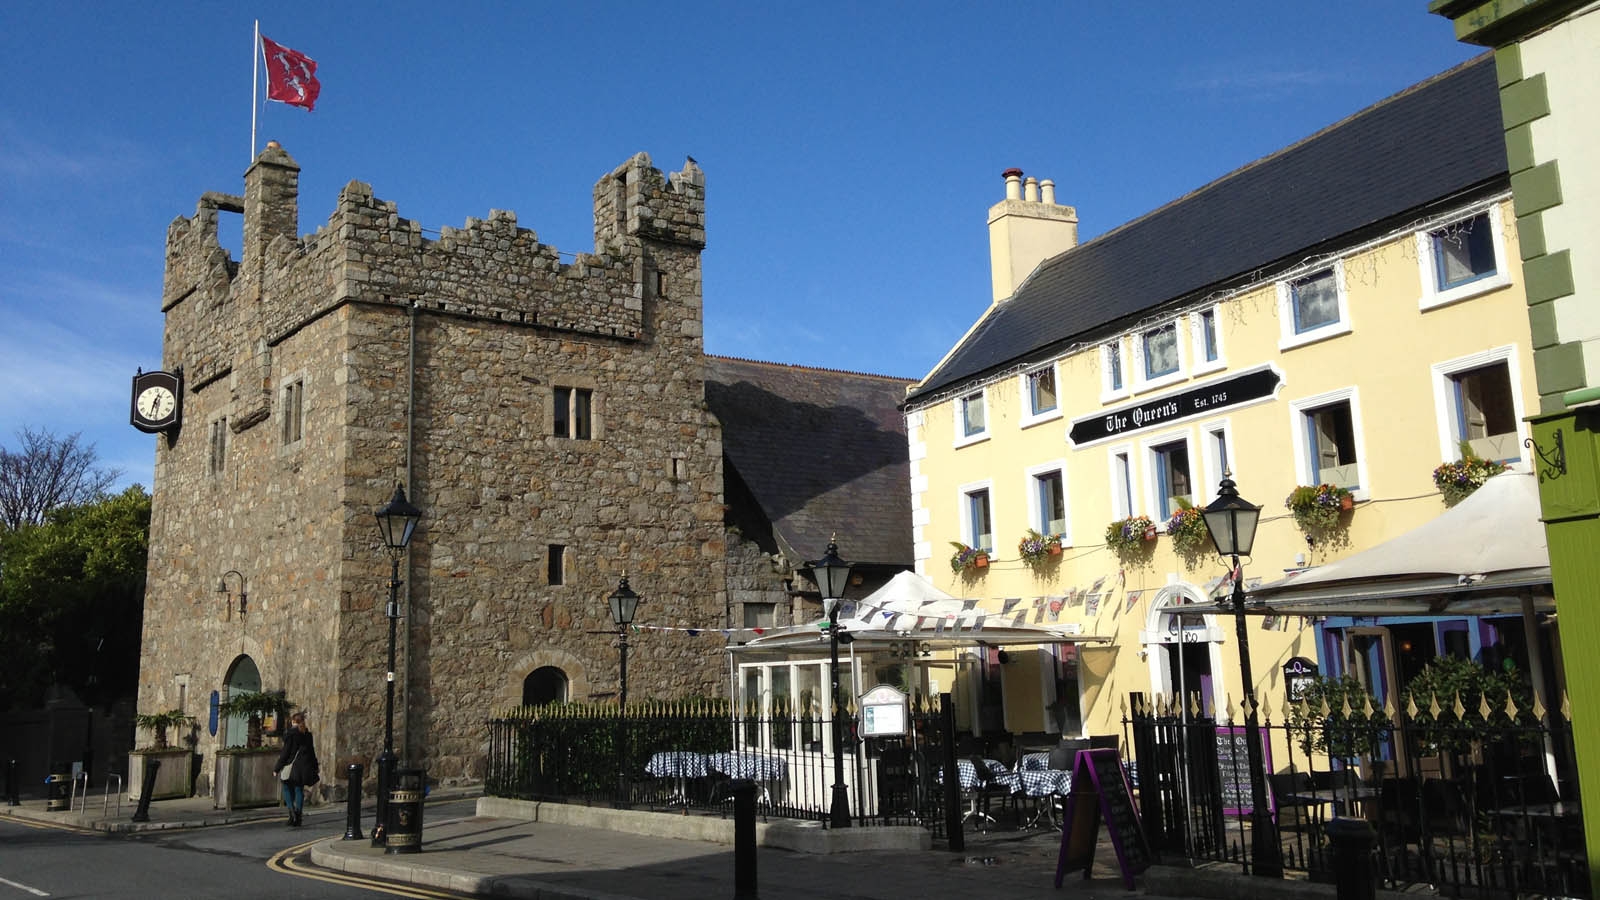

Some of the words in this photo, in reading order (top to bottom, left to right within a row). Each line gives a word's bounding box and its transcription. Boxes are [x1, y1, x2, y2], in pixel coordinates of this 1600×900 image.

[1106, 415, 1128, 433] The
[1133, 402, 1178, 427] Queen's
[1194, 398, 1210, 409] Est.
[1212, 392, 1228, 405] 1745
[1216, 736, 1231, 746] The
